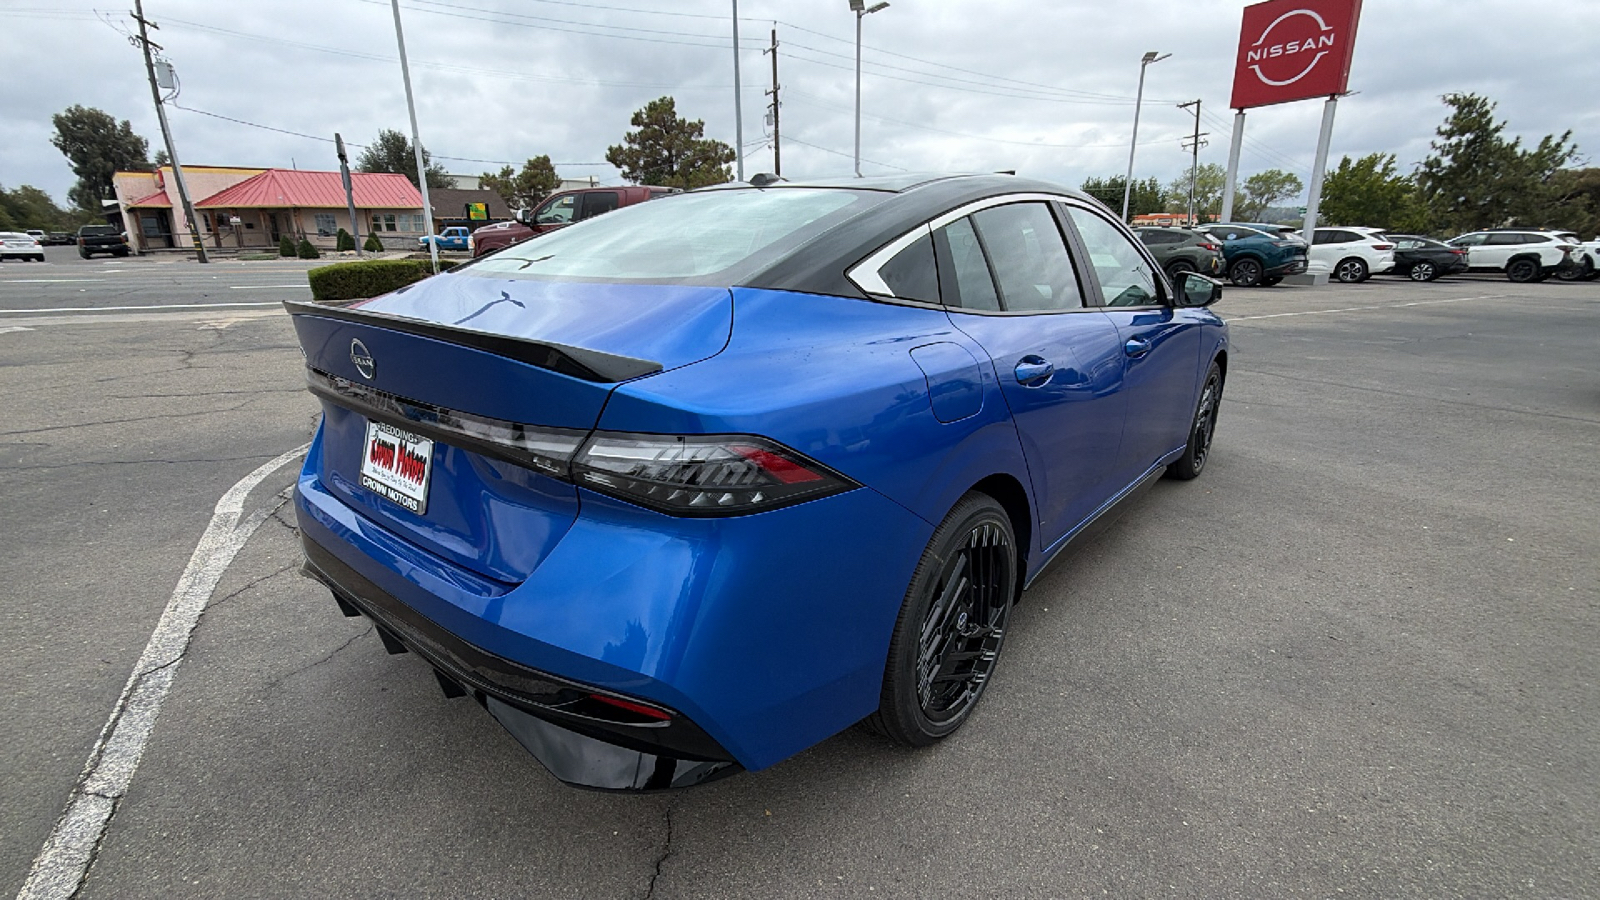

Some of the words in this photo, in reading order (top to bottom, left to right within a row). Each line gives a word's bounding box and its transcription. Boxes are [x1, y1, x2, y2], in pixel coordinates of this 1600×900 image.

[1246, 33, 1335, 63] NISSAN
[380, 423, 414, 442] REDDING
[395, 440, 427, 486] Motors
[363, 476, 387, 496] CROWN
[387, 487, 418, 511] MOTORS
